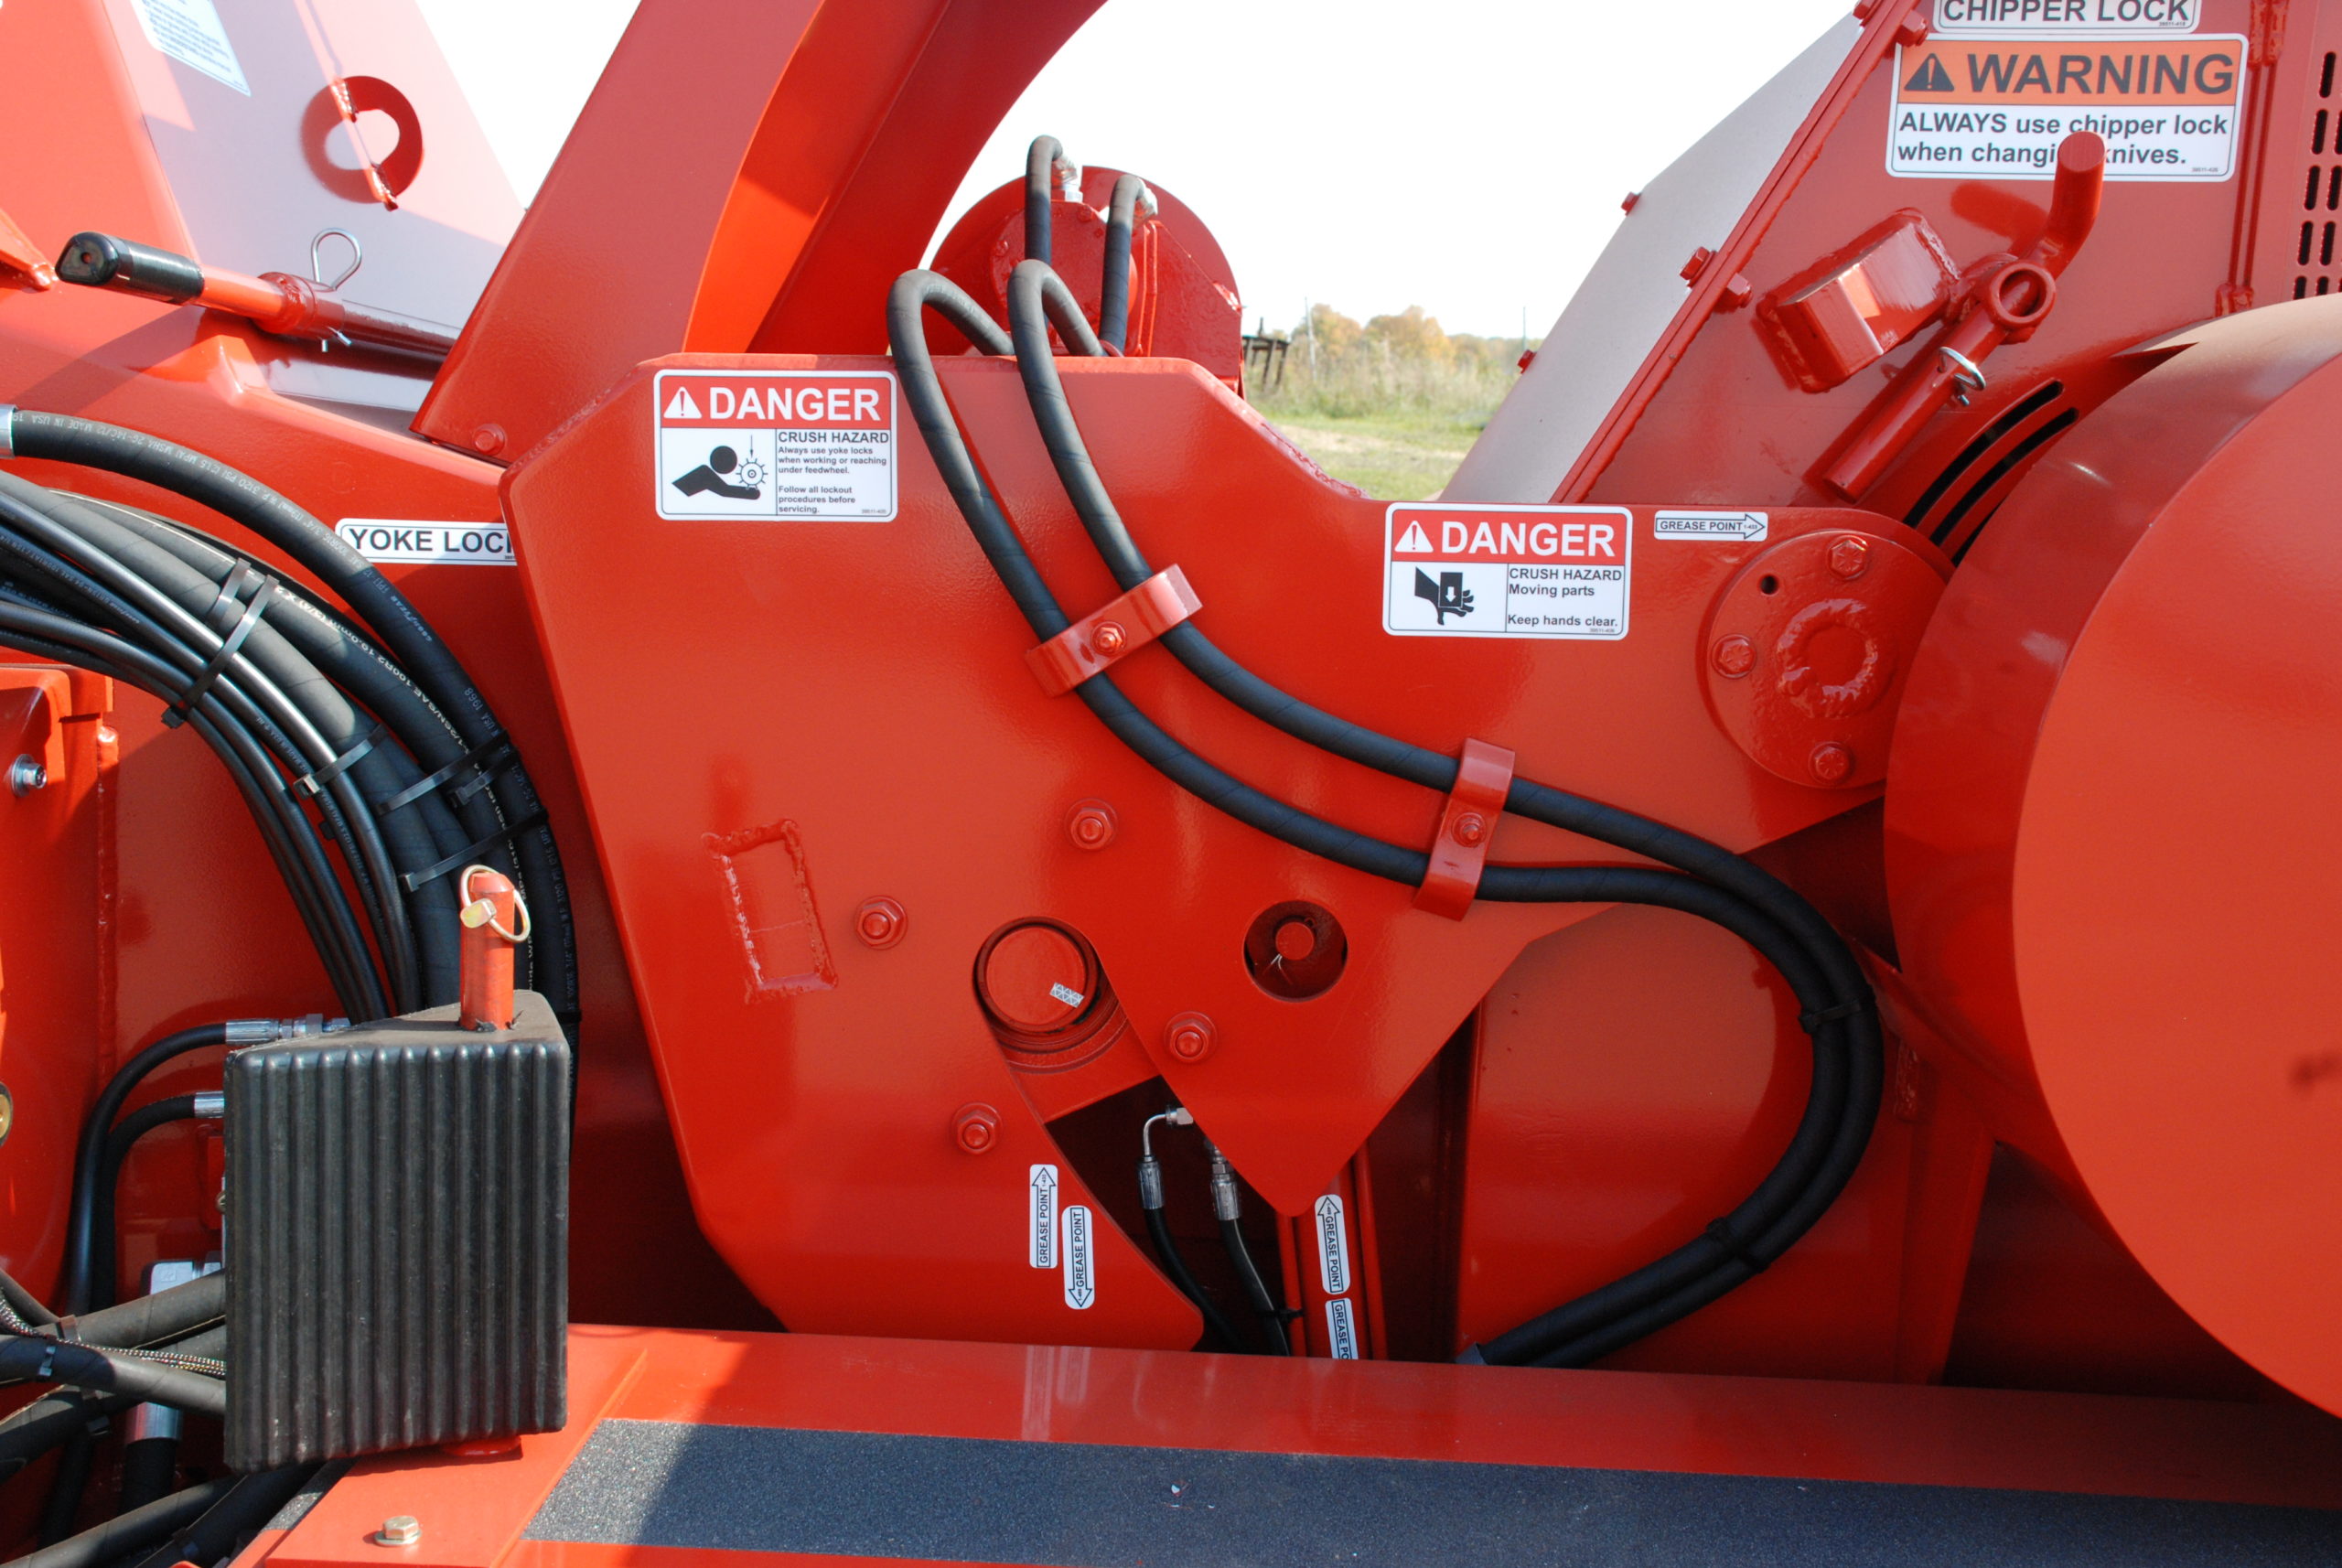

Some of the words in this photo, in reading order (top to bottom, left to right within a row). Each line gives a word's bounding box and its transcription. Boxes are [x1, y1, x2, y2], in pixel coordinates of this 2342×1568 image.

[1943, 0, 2087, 21] CHIPPER
[2098, 0, 2189, 21] LOCK
[1967, 53, 2234, 94] WARNING
[1899, 112, 2007, 133] ALWAYS
[2016, 117, 2060, 134] use
[2068, 114, 2165, 139] chipper
[2174, 115, 2228, 134] lock
[1898, 142, 1962, 161] when
[1971, 143, 2057, 168] changi
[709, 387, 881, 421] DANGER
[30, 414, 50, 425] USA
[779, 432, 827, 443] CRUSH
[831, 432, 889, 444] HAZARD
[779, 446, 808, 456] Always
[803, 457, 837, 466] working
[850, 457, 886, 467] reaching
[821, 486, 852, 494] lockout
[779, 505, 820, 514] servicing.
[1660, 521, 1706, 531] GREASE
[1709, 521, 1743, 531] POINT
[349, 529, 433, 551] YOKE
[1442, 521, 1616, 557] DANGER
[1509, 567, 1558, 580] CRUSH
[1563, 568, 1622, 582] HAZARD
[1509, 584, 1558, 597] Moving
[1562, 585, 1595, 597] parts
[1508, 614, 1539, 628] Keep
[1543, 615, 1581, 627] hands
[1585, 616, 1618, 627] clear.
[462, 686, 483, 710] 1968
[479, 712, 496, 729] USA
[1039, 1187, 1048, 1217] POINT
[1073, 1211, 1082, 1242] POINT
[1326, 1216, 1338, 1256] GREASE
[1039, 1221, 1048, 1263] GREASE
[1074, 1245, 1085, 1287] GREASE
[1329, 1259, 1340, 1288] POINT
[1334, 1304, 1348, 1345] GREASE
